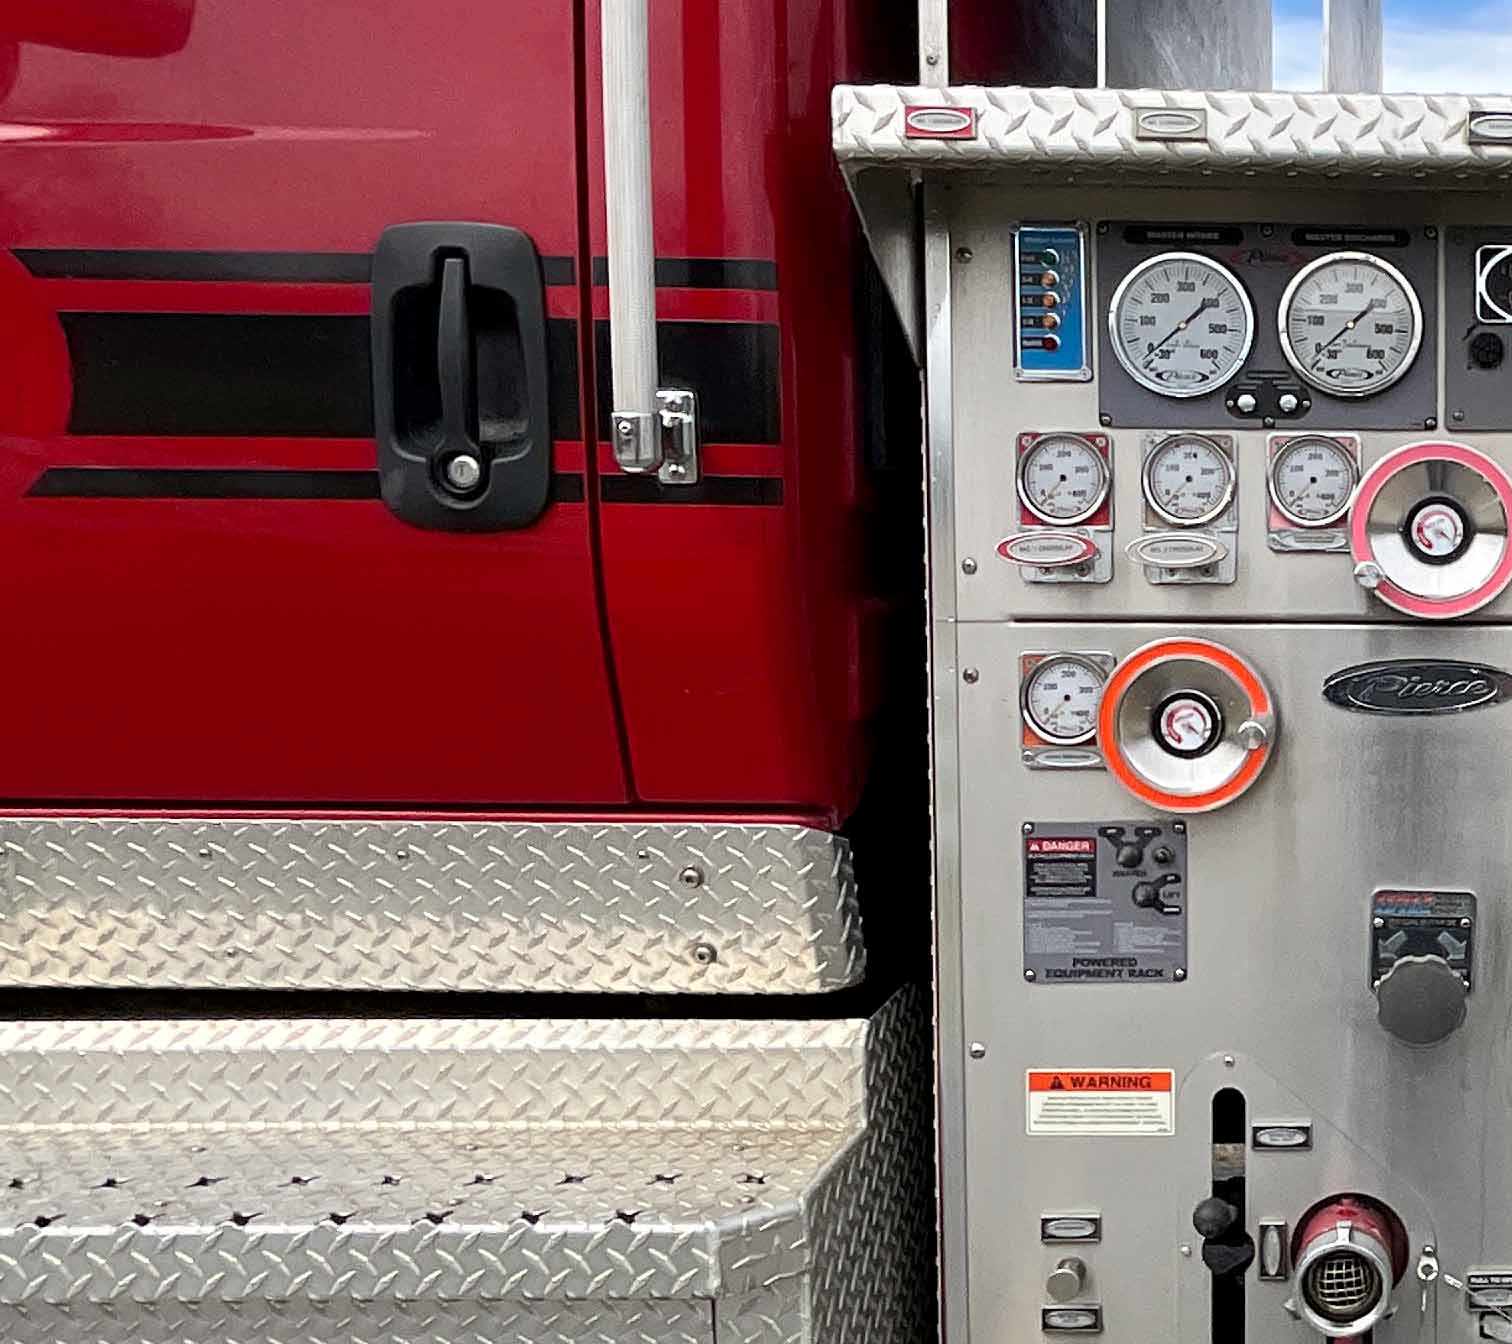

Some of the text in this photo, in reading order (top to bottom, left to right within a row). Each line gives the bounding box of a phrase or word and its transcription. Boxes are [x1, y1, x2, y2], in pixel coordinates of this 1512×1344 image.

[1358, 673, 1491, 703] Pierce
[1042, 840, 1090, 852] DANGER
[1072, 957, 1138, 968] POWERED
[1045, 968, 1164, 978] EQUIPMENT RACK
[1070, 1075, 1152, 1089] WARNING
